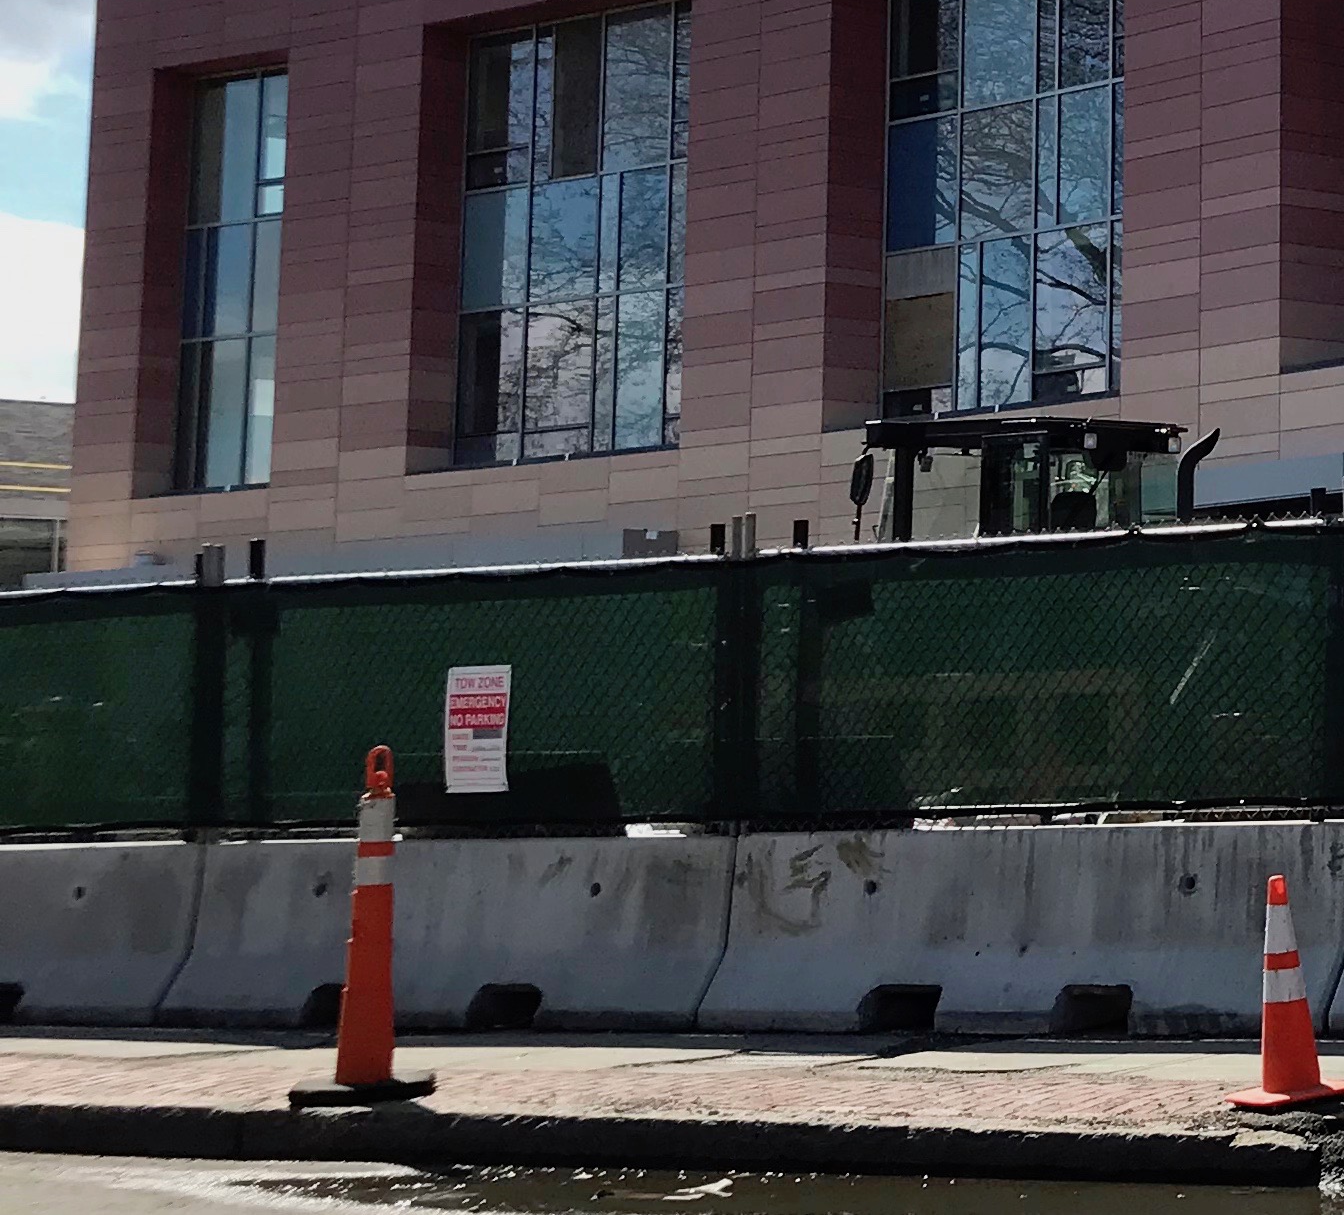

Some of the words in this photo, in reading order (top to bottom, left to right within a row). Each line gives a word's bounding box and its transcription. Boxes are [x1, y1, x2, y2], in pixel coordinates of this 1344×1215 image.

[455, 677, 475, 689] TOW
[478, 676, 505, 688] ZONE
[450, 695, 507, 709] EMERGENCY
[450, 713, 464, 727] NO
[465, 712, 505, 726] PARKING
